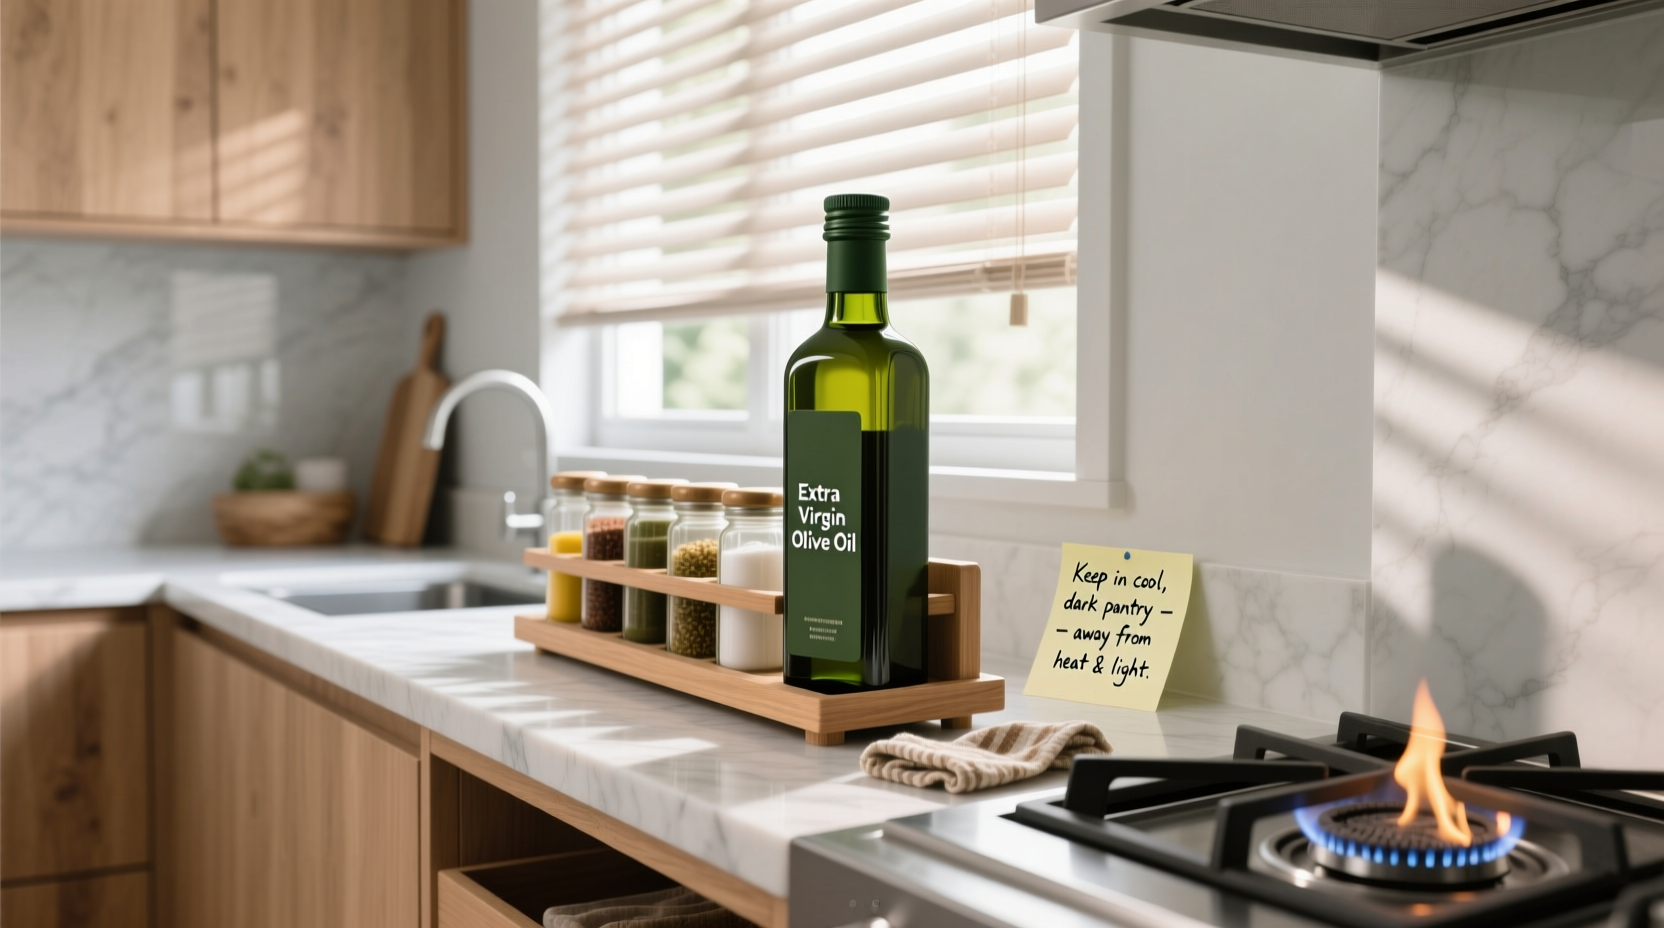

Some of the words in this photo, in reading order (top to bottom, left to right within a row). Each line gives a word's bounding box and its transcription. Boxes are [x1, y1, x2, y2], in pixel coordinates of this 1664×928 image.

[798, 483, 840, 502] Extra
[798, 506, 846, 531] Virgin
[791, 530, 831, 551] Olive
[833, 532, 856, 552] Oil
[1072, 561, 1108, 591] Keep
[1113, 570, 1127, 586] in
[1133, 569, 1167, 594] cool,
[1063, 591, 1098, 612] dark
[1102, 598, 1153, 626] pantry
[1073, 628, 1111, 651] away
[1115, 624, 1152, 647] from
[1053, 650, 1089, 670] heat
[1092, 655, 1104, 674] &
[1111, 656, 1149, 687] light.
